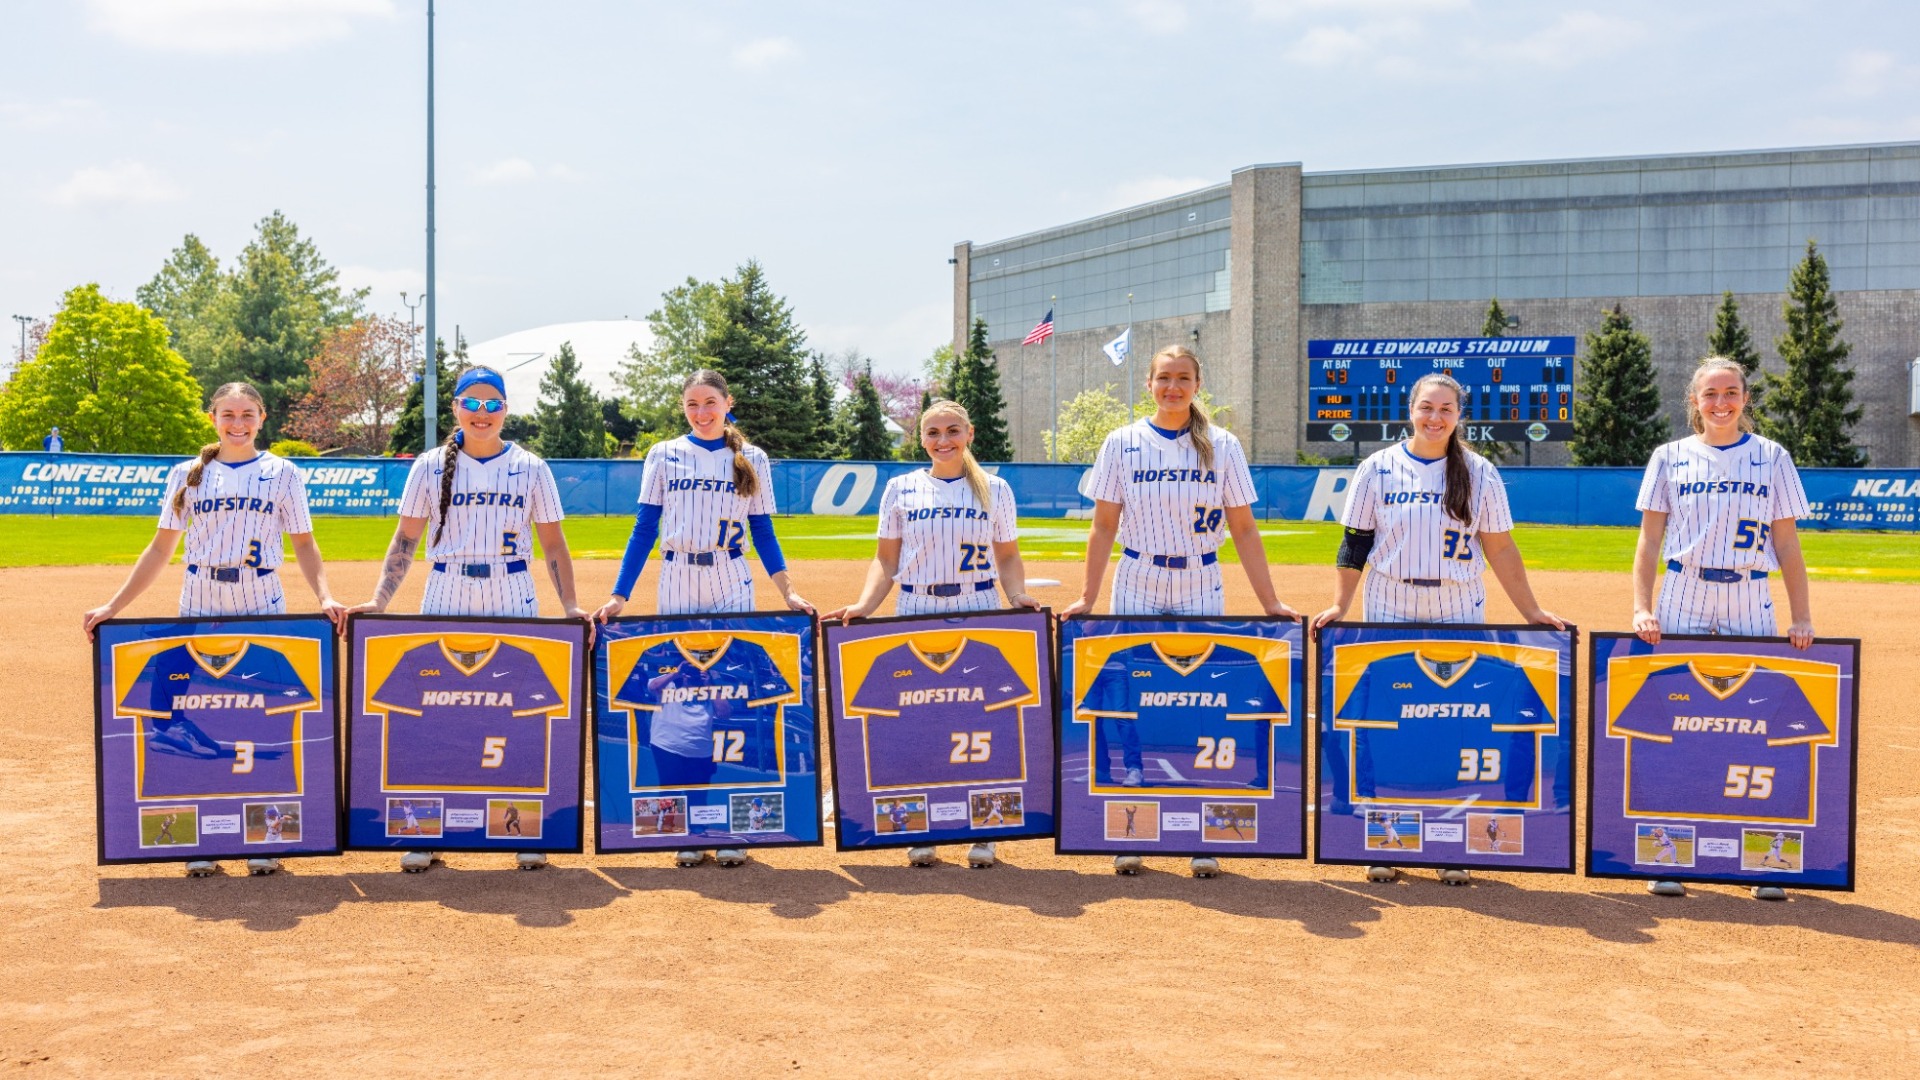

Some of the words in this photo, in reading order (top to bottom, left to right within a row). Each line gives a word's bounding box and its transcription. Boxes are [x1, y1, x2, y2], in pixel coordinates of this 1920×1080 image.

[1332, 342, 1368, 355] BILL
[1373, 341, 1461, 354] EDWARDS
[1464, 340, 1550, 353] STADIUM
[1322, 360, 1333, 369] AT
[1335, 360, 1352, 369] BAT
[1380, 359, 1402, 369] BALL
[1433, 359, 1464, 368] STRIKE
[1487, 358, 1507, 367] OUT
[1546, 357, 1562, 367] H/E
[1386, 369, 1396, 383] 0
[1492, 368, 1502, 382] 0
[1482, 385, 1491, 393] 10
[1556, 384, 1571, 392] ERR
[1327, 395, 1342, 404] HU
[1511, 393, 1519, 405] 0
[1540, 392, 1548, 404] 0
[1560, 392, 1568, 404] 0
[1317, 409, 1352, 419] PRIDE
[1511, 408, 1519, 420] 0
[1540, 408, 1548, 420] 0
[1559, 407, 1568, 420] 0
[1133, 469, 1216, 484] HOFSTRA
[11, 486, 39, 494] 1992
[52, 486, 80, 495] 1993
[92, 487, 119, 496] 1994
[132, 488, 159, 496] 1995
[323, 489, 350, 497] 2002
[362, 489, 389, 497] 2003
[668, 478, 738, 494] HOFSTR
[1679, 481, 1768, 498] HOFSTRA
[32, 497, 62, 505] 2005
[74, 497, 104, 506] 2006
[116, 498, 145, 506] 2007
[309, 498, 334, 506] 2015
[345, 498, 371, 507] 2018
[193, 497, 274, 514] HOFSTRA
[450, 492, 524, 509] OFSTRA
[1384, 491, 1443, 505] HOFST
[907, 507, 988, 521] HOFSTRA
[1836, 502, 1864, 511] 1995
[1877, 503, 1905, 511] 1999
[1843, 513, 1873, 521] 2008
[1886, 513, 1914, 522] 2010
[717, 517, 744, 550] 12
[245, 538, 262, 568] 3
[169, 673, 190, 681] CAA
[893, 669, 912, 678] CAA
[422, 691, 513, 707] HOFSTRA
[661, 685, 748, 703] HOFSTRA
[899, 687, 984, 706] HOFSTRA
[1140, 691, 1227, 707] HOFSTRA
[1668, 693, 1690, 701] CAA
[172, 694, 265, 710] HOFSTRA
[1400, 703, 1491, 718] HOFSTRA
[1672, 715, 1767, 734] HOFSTRA
[481, 737, 507, 768] 5
[712, 730, 745, 762] 12
[950, 731, 992, 764] 25
[1194, 737, 1236, 769] 28
[232, 741, 254, 773] 3
[1457, 748, 1501, 781] 33
[1724, 764, 1775, 800] 55
